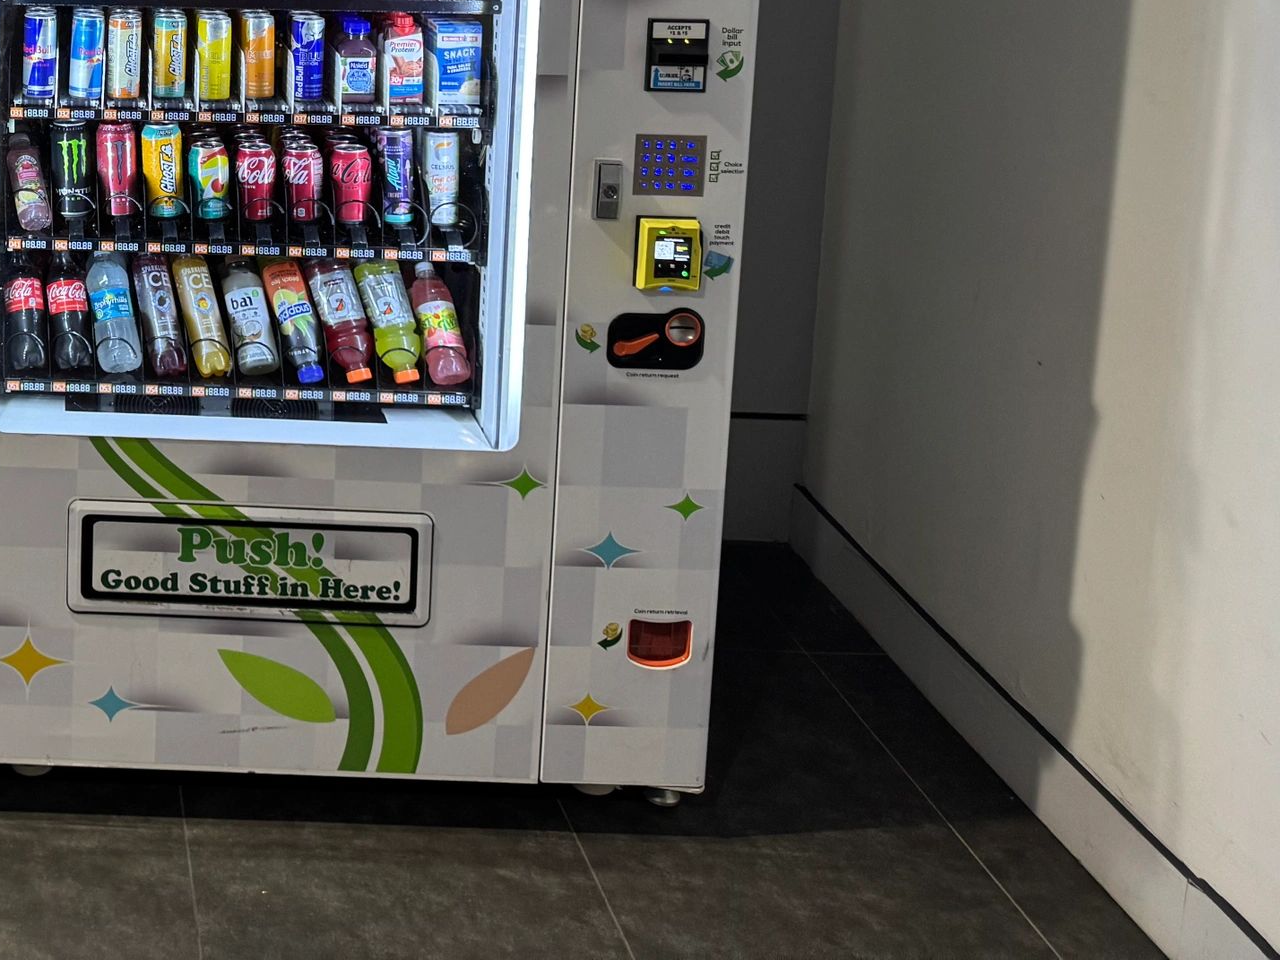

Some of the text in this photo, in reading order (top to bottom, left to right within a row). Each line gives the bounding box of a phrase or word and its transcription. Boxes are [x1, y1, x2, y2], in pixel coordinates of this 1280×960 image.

[390, 41, 417, 50] Premier
[443, 48, 476, 60] SNACK
[295, 66, 304, 98] Red Bull
[177, 527, 325, 568] Push!
[100, 569, 401, 601] Good Stuff in Here!
